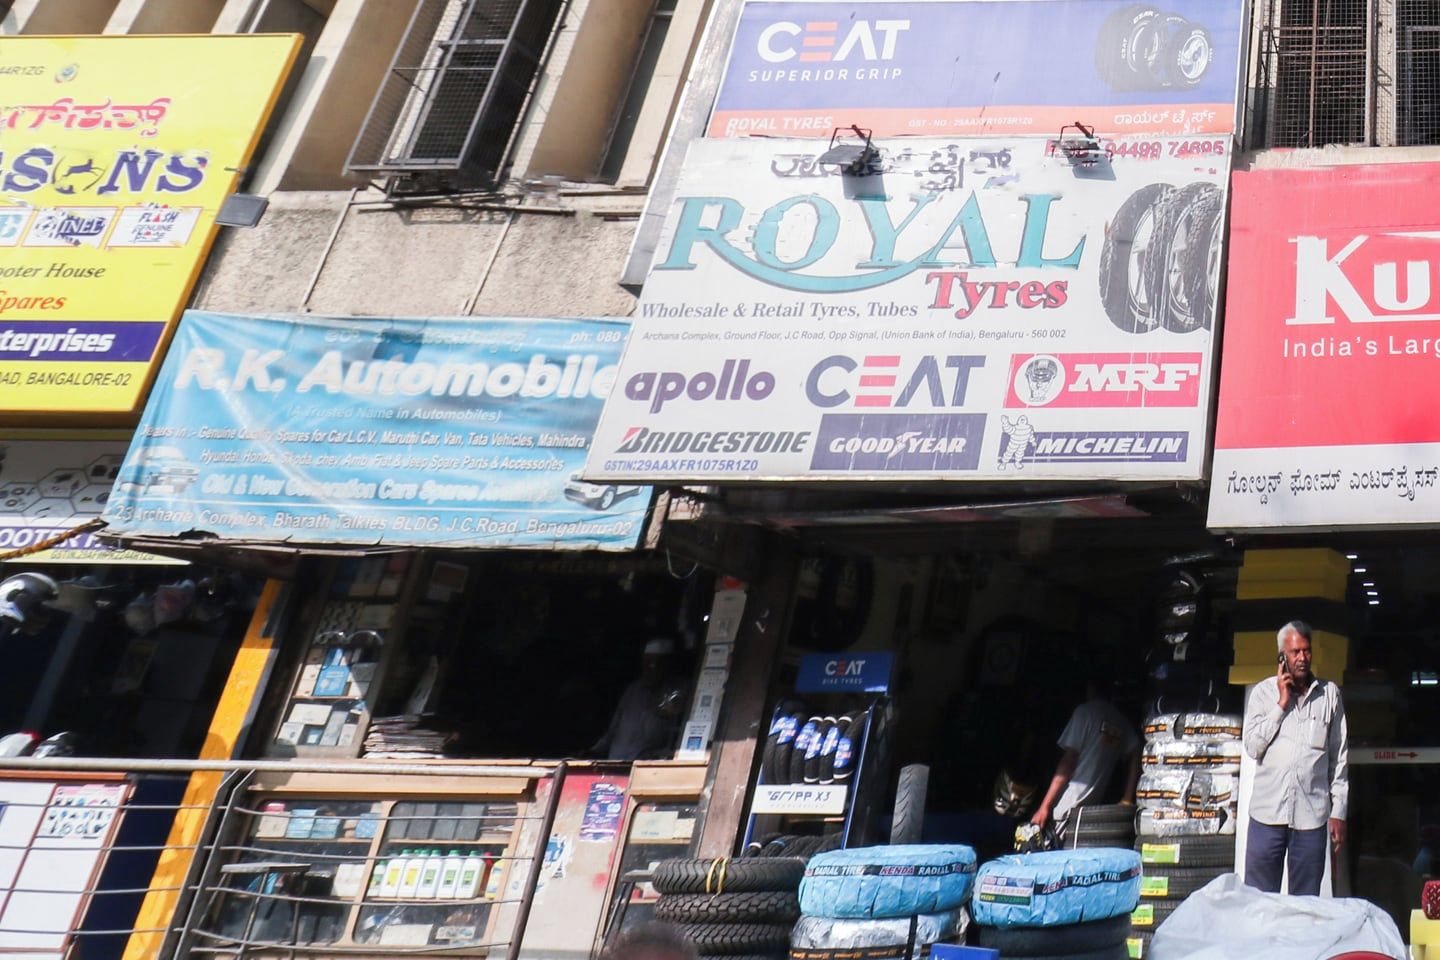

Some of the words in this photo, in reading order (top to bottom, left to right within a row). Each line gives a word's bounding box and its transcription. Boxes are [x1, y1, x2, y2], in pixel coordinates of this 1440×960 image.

[757, 20, 911, 63] CEAT
[748, 69, 847, 82] SUPERIOR
[855, 68, 902, 81] GRIP
[728, 117, 777, 132] ROYAL
[783, 116, 833, 129] TYRES
[653, 190, 1087, 294] ROYAL
[45, 262, 106, 279] House
[926, 270, 1070, 321] Tyres
[642, 302, 729, 319] Wholesale
[732, 303, 748, 318] &
[751, 302, 804, 318] Retail
[809, 302, 861, 321] Tyres,
[867, 301, 918, 317] Tubes
[642, 331, 679, 340] Archana
[723, 331, 757, 341] Ground
[758, 331, 783, 342] Floor,
[800, 331, 826, 342] Road,
[828, 331, 847, 342] Opp
[849, 330, 879, 342] Signal,
[881, 330, 910, 340] (Union
[912, 330, 935, 339] Bank
[936, 330, 946, 339] of
[948, 330, 976, 341] India),
[978, 330, 1024, 341] Bengaluru
[1031, 329, 1047, 339] 560
[1049, 329, 1066, 338] 002
[1283, 336, 1379, 359] India's
[26, 371, 132, 387] BANGALORE-02
[175, 350, 286, 392] R.K.
[805, 354, 987, 408] CEAT
[1067, 362, 1199, 392] MRF
[624, 359, 776, 414] apollo
[306, 407, 352, 420] Trusted
[357, 407, 393, 420] Name
[396, 407, 410, 420] in
[412, 407, 502, 424] Automobiles)
[198, 425, 237, 440] Genuine
[277, 428, 310, 444] Spares
[311, 428, 328, 443] for
[327, 429, 348, 444] Car
[381, 431, 419, 446] Maruthi
[421, 432, 441, 448] Car,
[443, 432, 464, 448] Van,
[467, 432, 489, 447] Tata
[491, 432, 535, 449] Vehicles,
[537, 432, 586, 450] Mahindra
[615, 427, 812, 454] BRIDGESTONE
[1033, 434, 1184, 456] MICHELIN
[403, 456, 427, 471] Jeep
[431, 456, 460, 472] Spare
[463, 456, 490, 470] Parts
[492, 457, 499, 470] &
[500, 456, 565, 472] Accessories
[202, 474, 233, 494] Old
[235, 475, 247, 495] &
[248, 475, 285, 496] New
[378, 479, 418, 501] Cars
[272, 510, 331, 529] Bharath
[334, 512, 386, 531] Talkies
[526, 517, 633, 537] Bengaluru-02
[825, 659, 867, 676] CEAT
[918, 865, 950, 876] RADIAL
